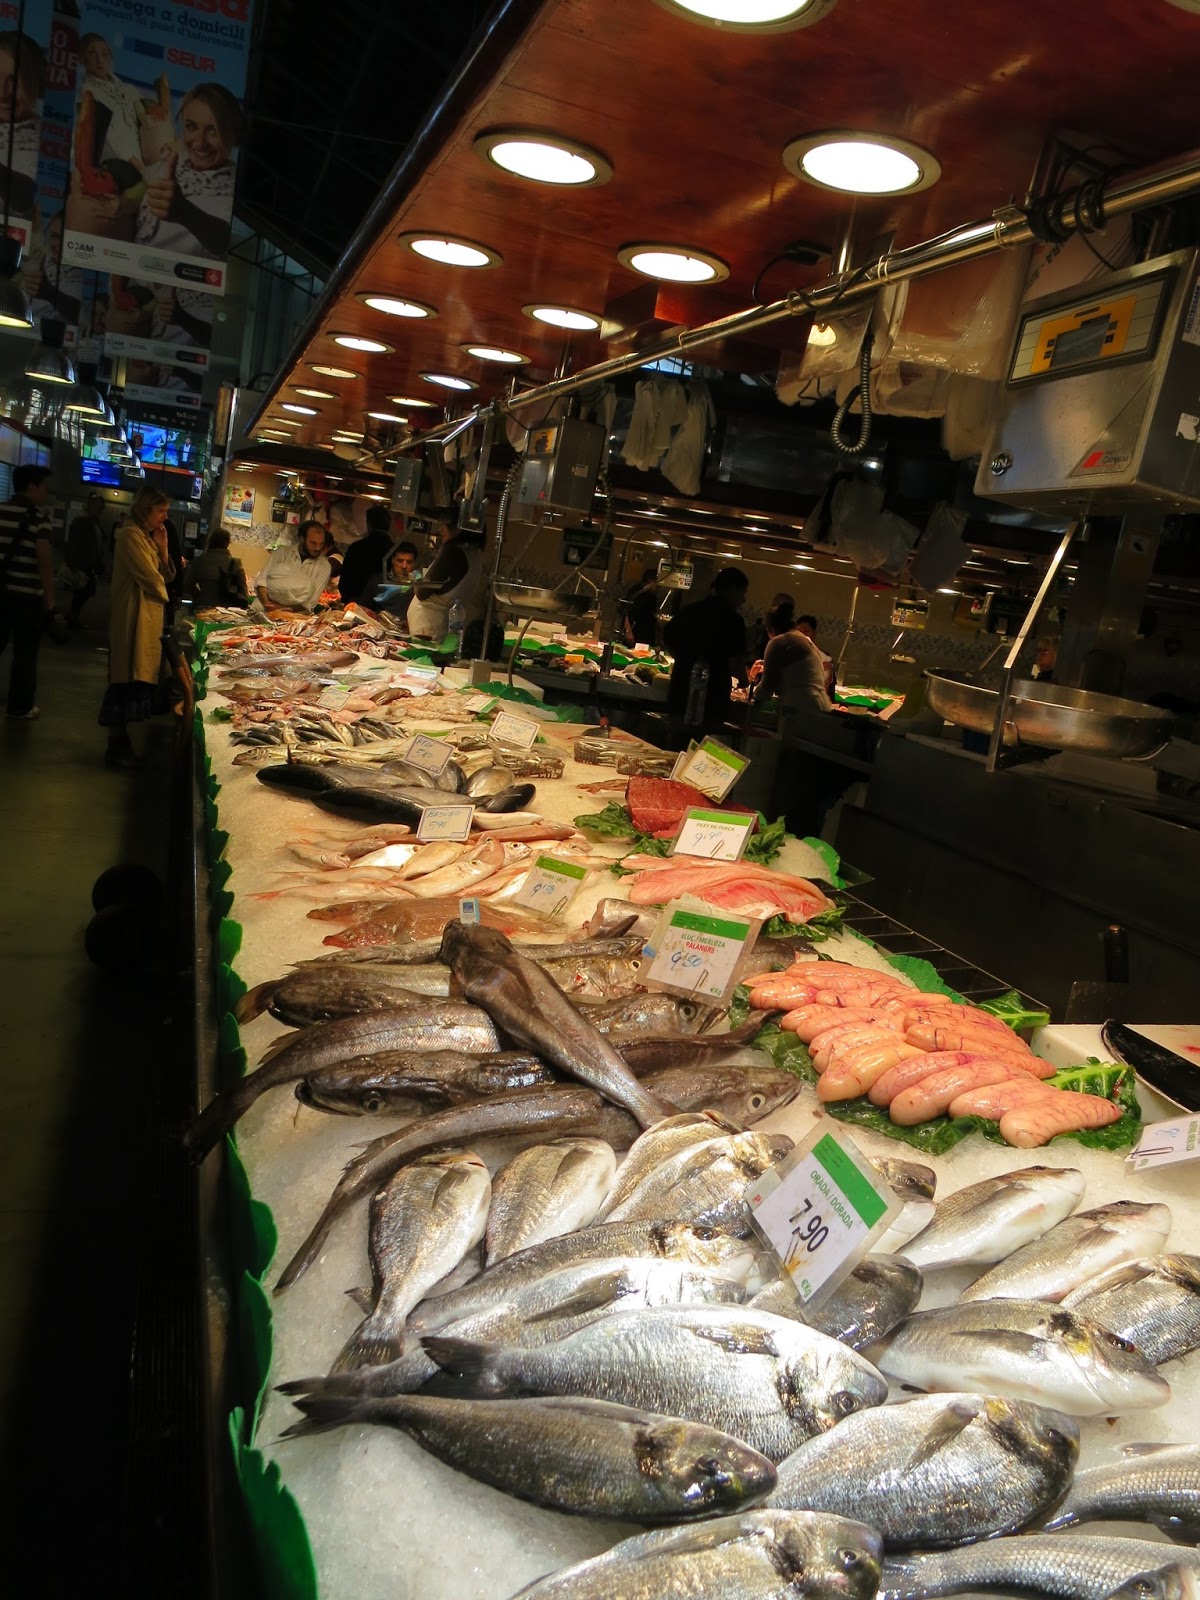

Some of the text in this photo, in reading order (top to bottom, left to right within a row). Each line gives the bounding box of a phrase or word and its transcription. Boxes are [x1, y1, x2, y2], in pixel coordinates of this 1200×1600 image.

[177, 11, 245, 41] domicili
[167, 48, 215, 73] SEUR
[685, 941, 716, 954] PALANGRE
[700, 935, 726, 948] MERLUZA
[810, 1170, 831, 1198] ORADA
[830, 1197, 854, 1230] DORADA
[800, 1279, 813, 1298] €Kg
